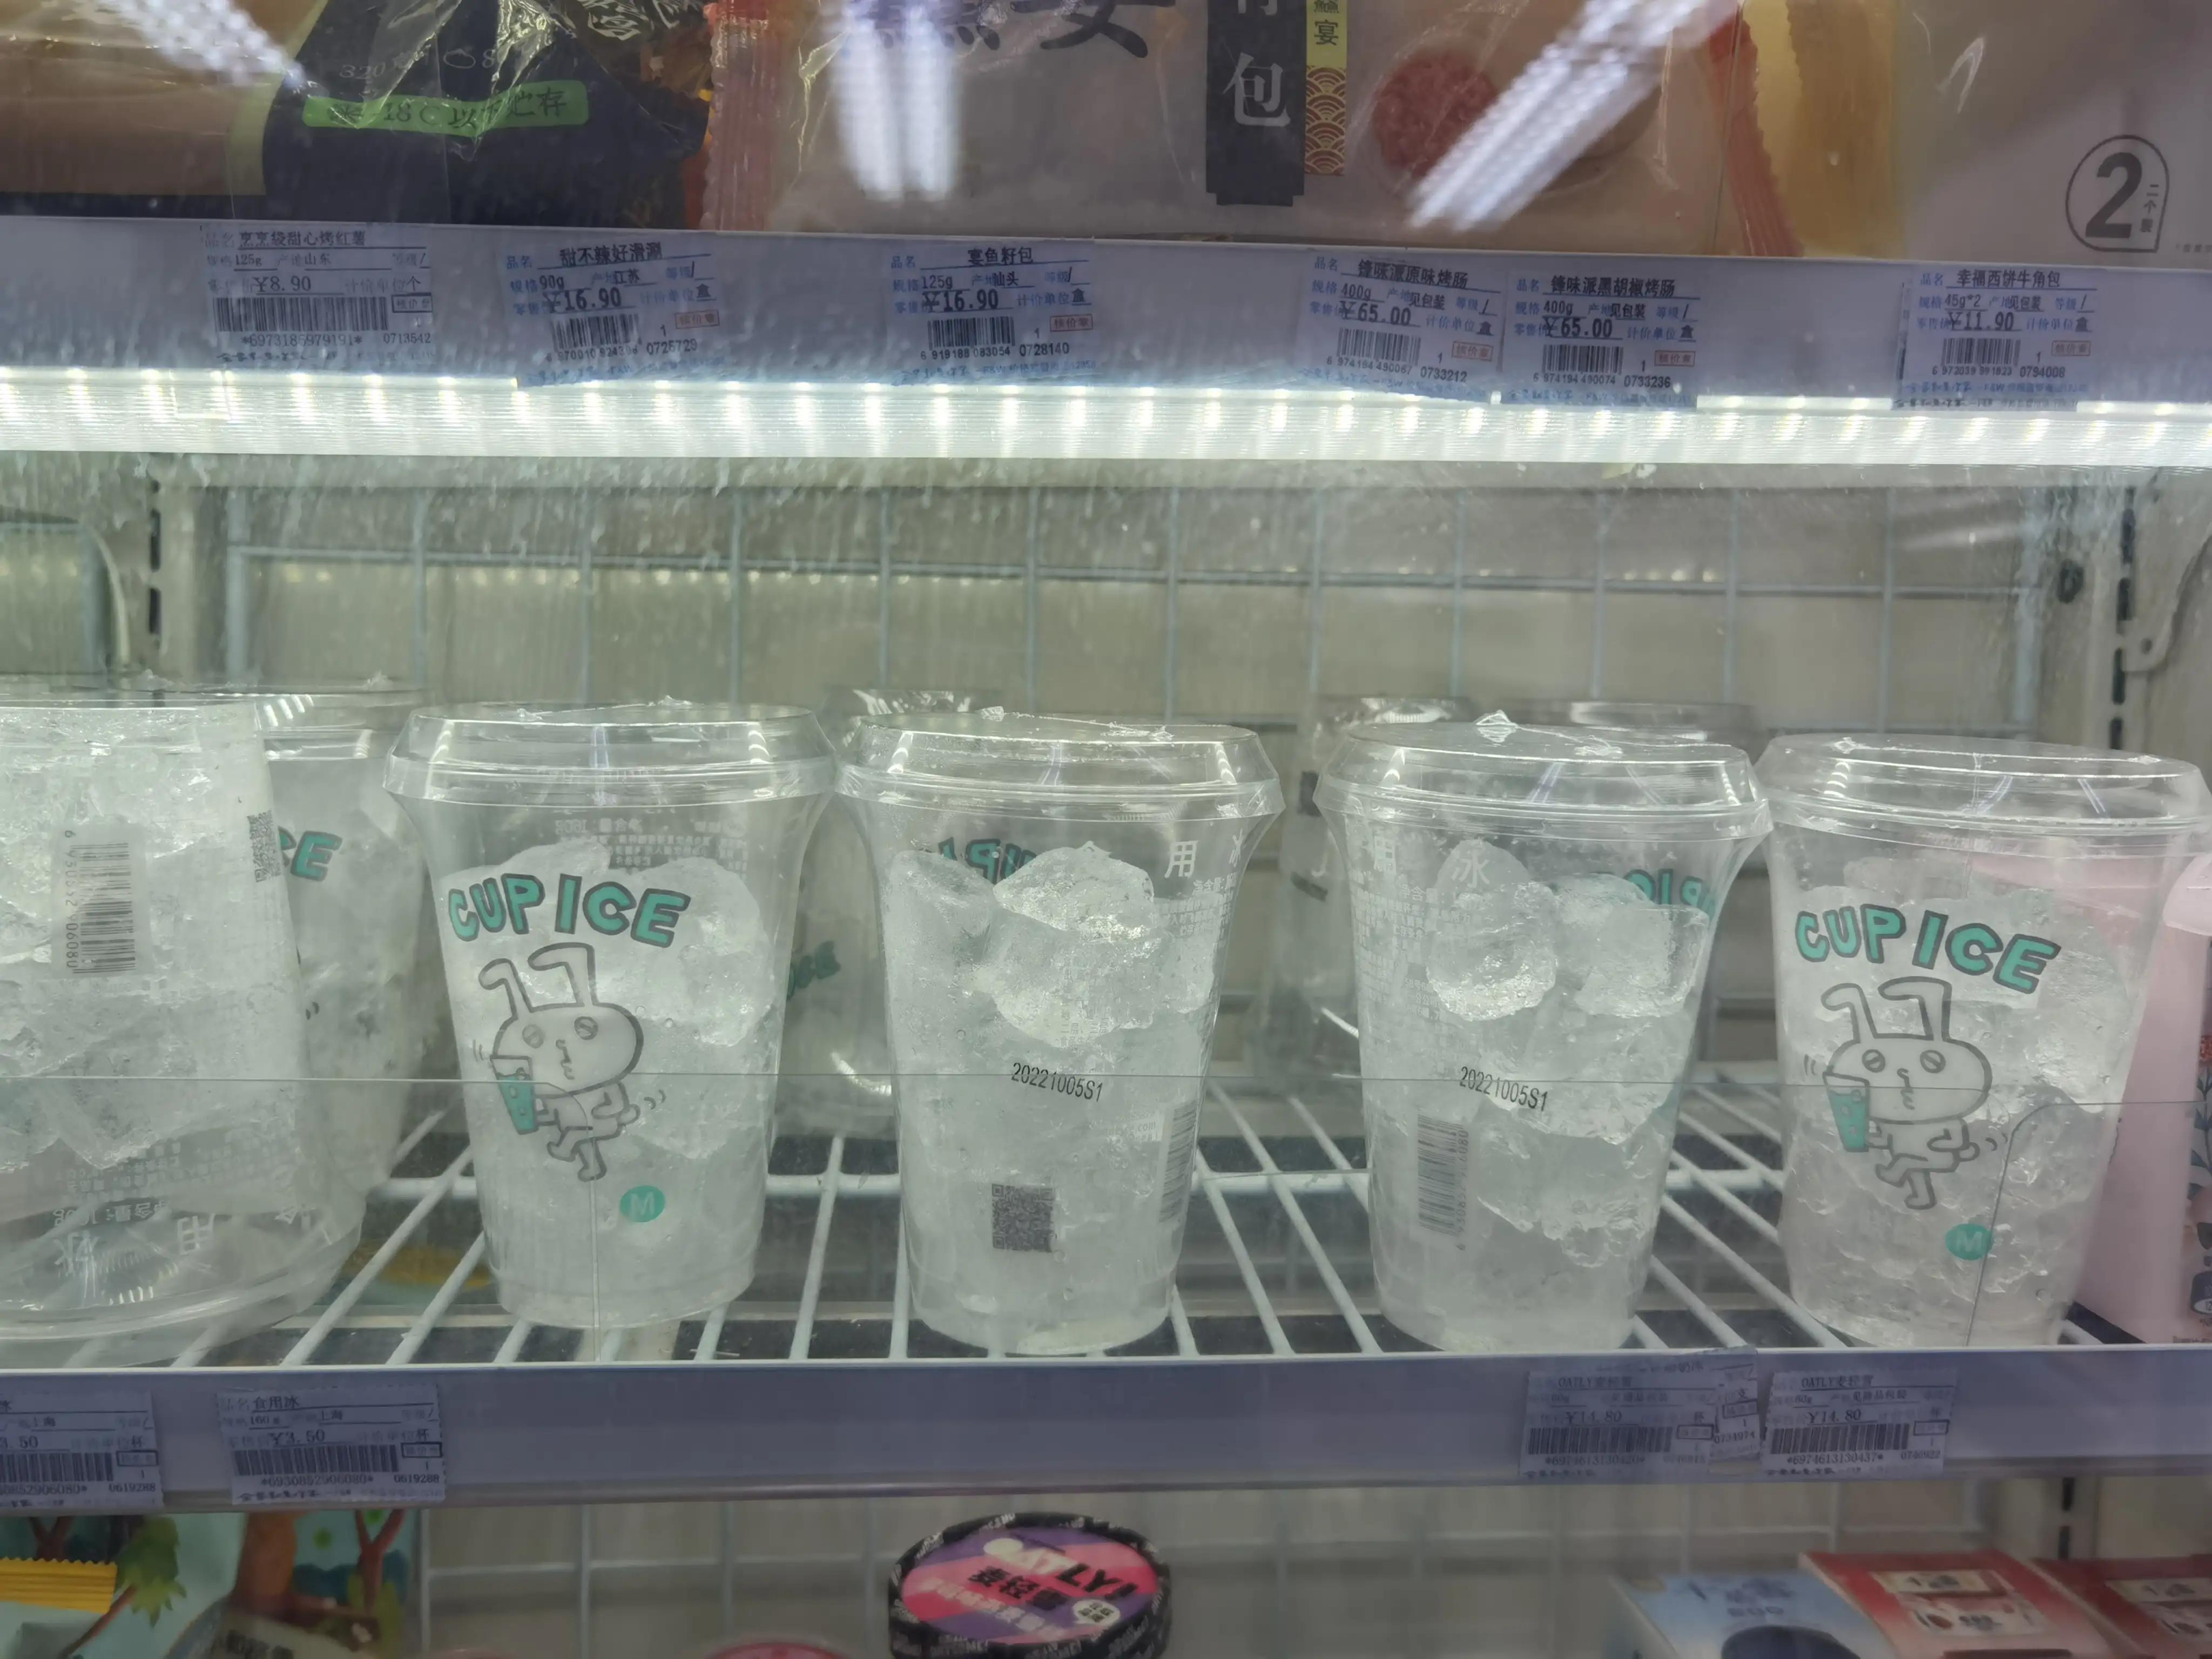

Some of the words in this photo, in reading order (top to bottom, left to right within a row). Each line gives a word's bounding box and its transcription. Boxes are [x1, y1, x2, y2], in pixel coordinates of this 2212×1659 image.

[2085, 152, 2142, 239] 2
[235, 254, 262, 267] 125g
[891, 255, 916, 269] 品名
[254, 276, 312, 292] ¥8.90
[539, 274, 565, 291] 90g
[922, 275, 954, 290] 125g
[922, 289, 1000, 313] ¥16.90
[1071, 288, 1085, 303] 盒
[1341, 284, 1372, 301] 400g
[1339, 300, 1412, 326] ¥65.00
[1543, 300, 1574, 316] 400g
[1542, 316, 1613, 338] ¥65.00
[1948, 312, 2015, 331] ¥11.90
[1019, 342, 1070, 357] 0728140
[1420, 366, 1468, 383] 0733212
[1623, 375, 1671, 389] 0733236
[1164, 840, 1201, 879] 用
[1451, 853, 1491, 888] 冰
[448, 873, 545, 942] CUP
[555, 873, 692, 948] ICE
[1795, 903, 1906, 965] CUP
[1912, 909, 2062, 995] ICE
[1011, 1062, 1104, 1103] 20221005S1
[1459, 1065, 1549, 1112] 20221005S1
[253, 1395, 300, 1410] 食用冰
